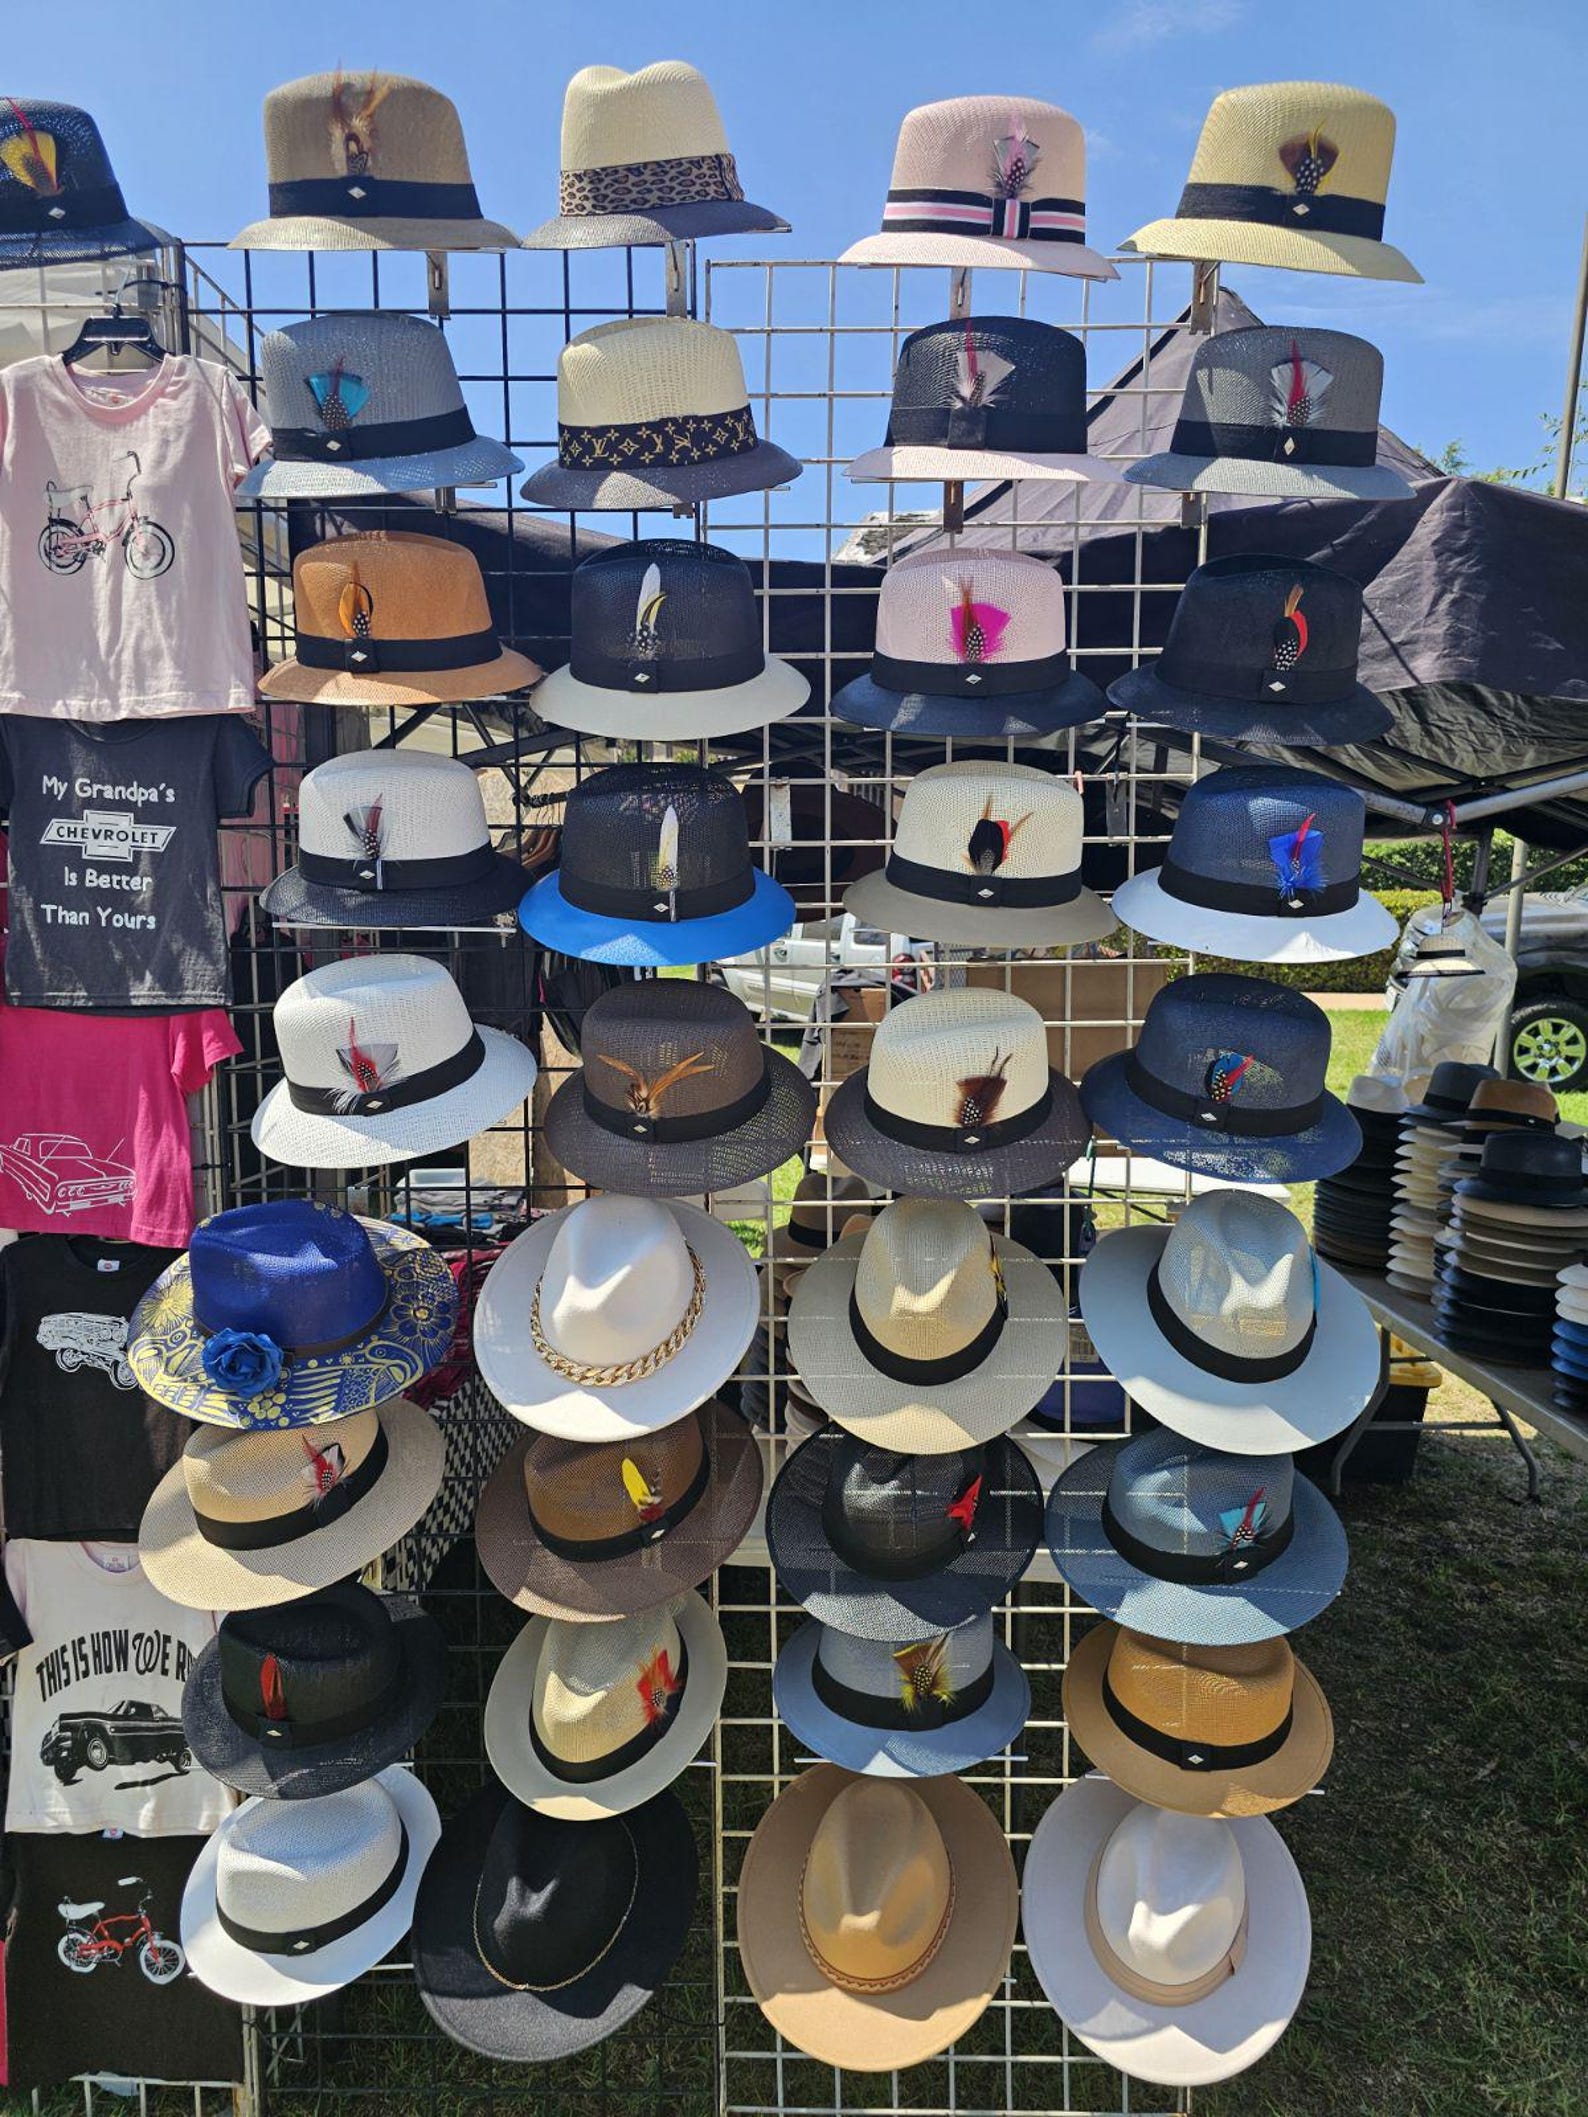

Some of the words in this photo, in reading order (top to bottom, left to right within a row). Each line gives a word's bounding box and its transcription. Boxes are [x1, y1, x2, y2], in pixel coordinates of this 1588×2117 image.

[42, 775, 68, 800] My
[75, 778, 175, 807] Grandpa's
[56, 826, 158, 844] CHEVROLET
[64, 866, 77, 886] Is
[85, 868, 152, 892] Better
[40, 904, 89, 925] Than
[97, 906, 156, 929] Yours
[36, 1644, 71, 1702] THIS
[71, 1636, 90, 1681] IS
[91, 1629, 128, 1675] HOW
[132, 1629, 171, 1676] WE
